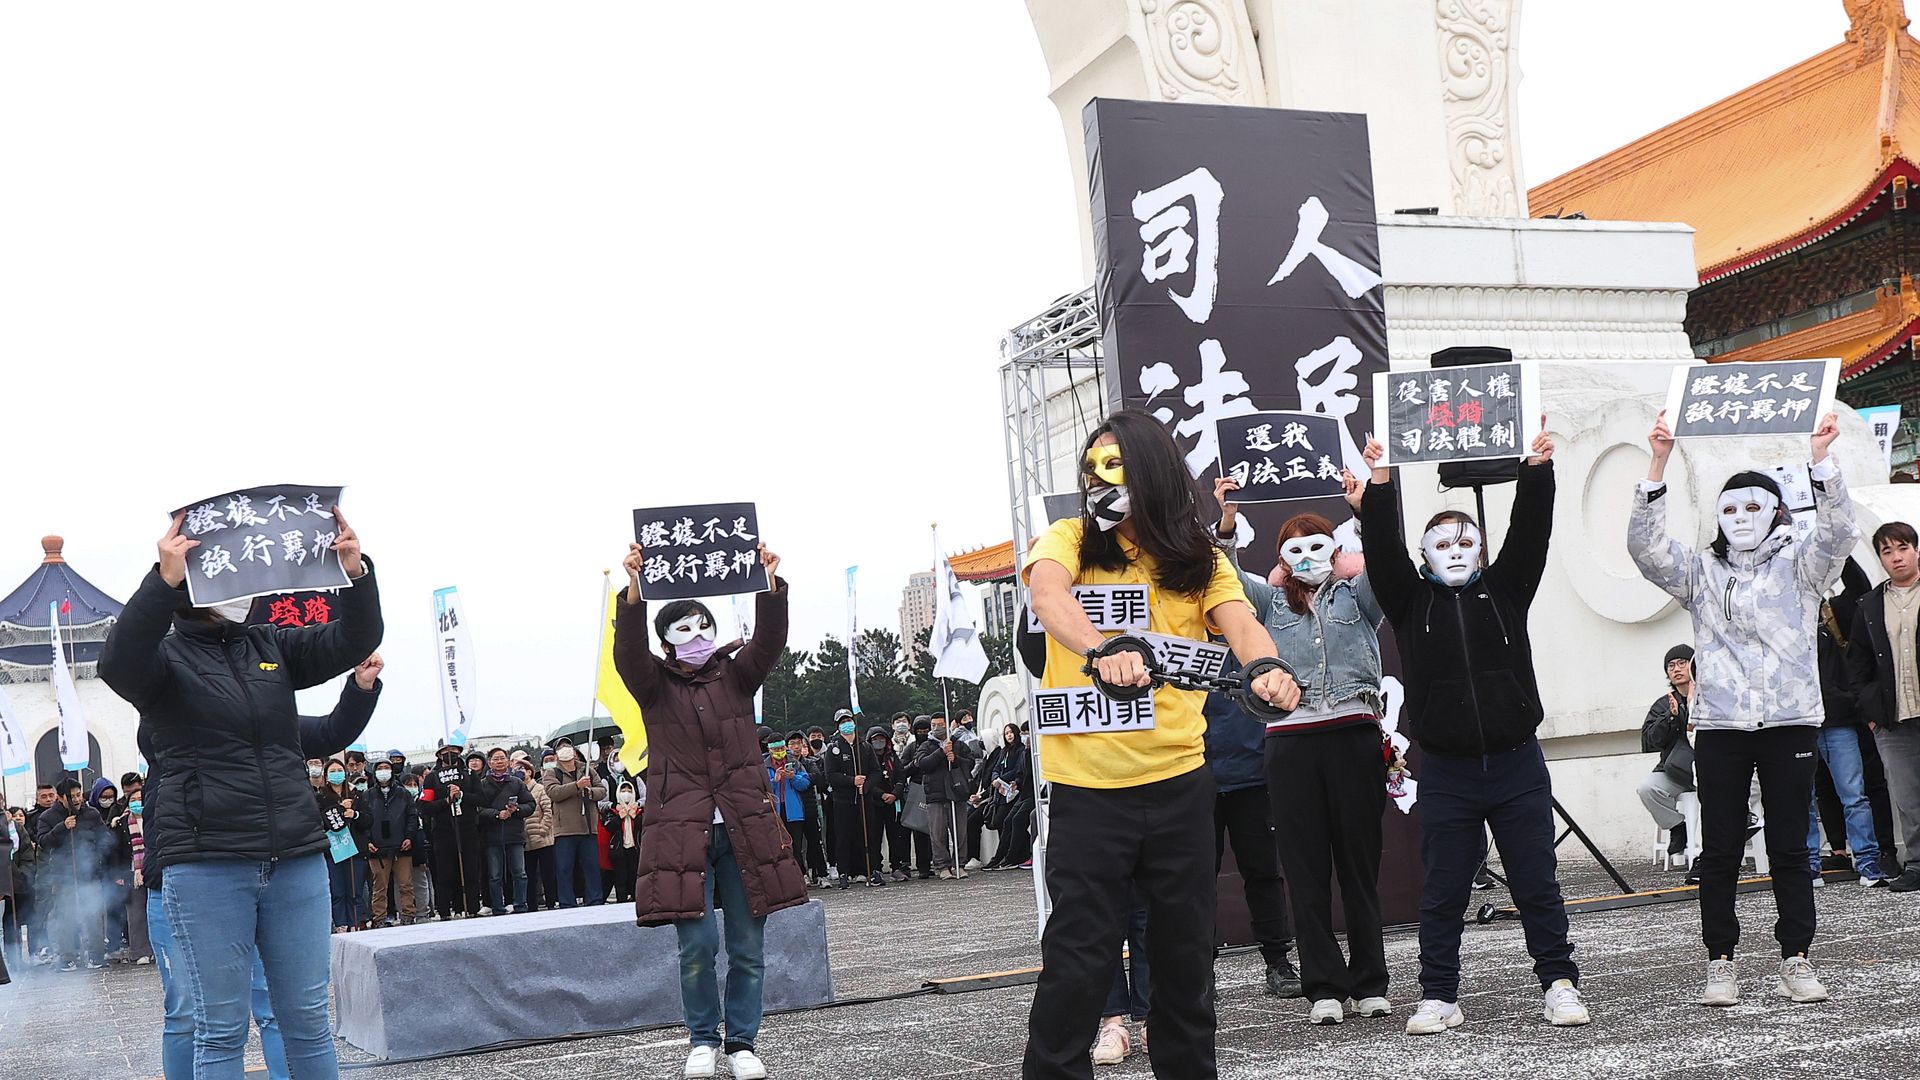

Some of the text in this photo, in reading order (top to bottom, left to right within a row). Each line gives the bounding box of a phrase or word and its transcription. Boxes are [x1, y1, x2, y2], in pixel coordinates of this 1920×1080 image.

[1396, 372, 1516, 405] 侵害人權
[1690, 372, 1817, 396] 證據不足
[1426, 401, 1484, 428] 踐踏
[1685, 398, 1811, 424] 強行羈押
[1245, 422, 1314, 452] 還我
[1400, 421, 1516, 454] 司法體制
[1229, 454, 1343, 488] 司法正義
[186, 493, 334, 535] 證據不足
[640, 516, 757, 548] 證據不足
[200, 529, 335, 579] 強行羈押
[643, 549, 757, 584] 強行羈押
[269, 596, 331, 626] 踐踏
[1032, 590, 1146, 626] 信罪
